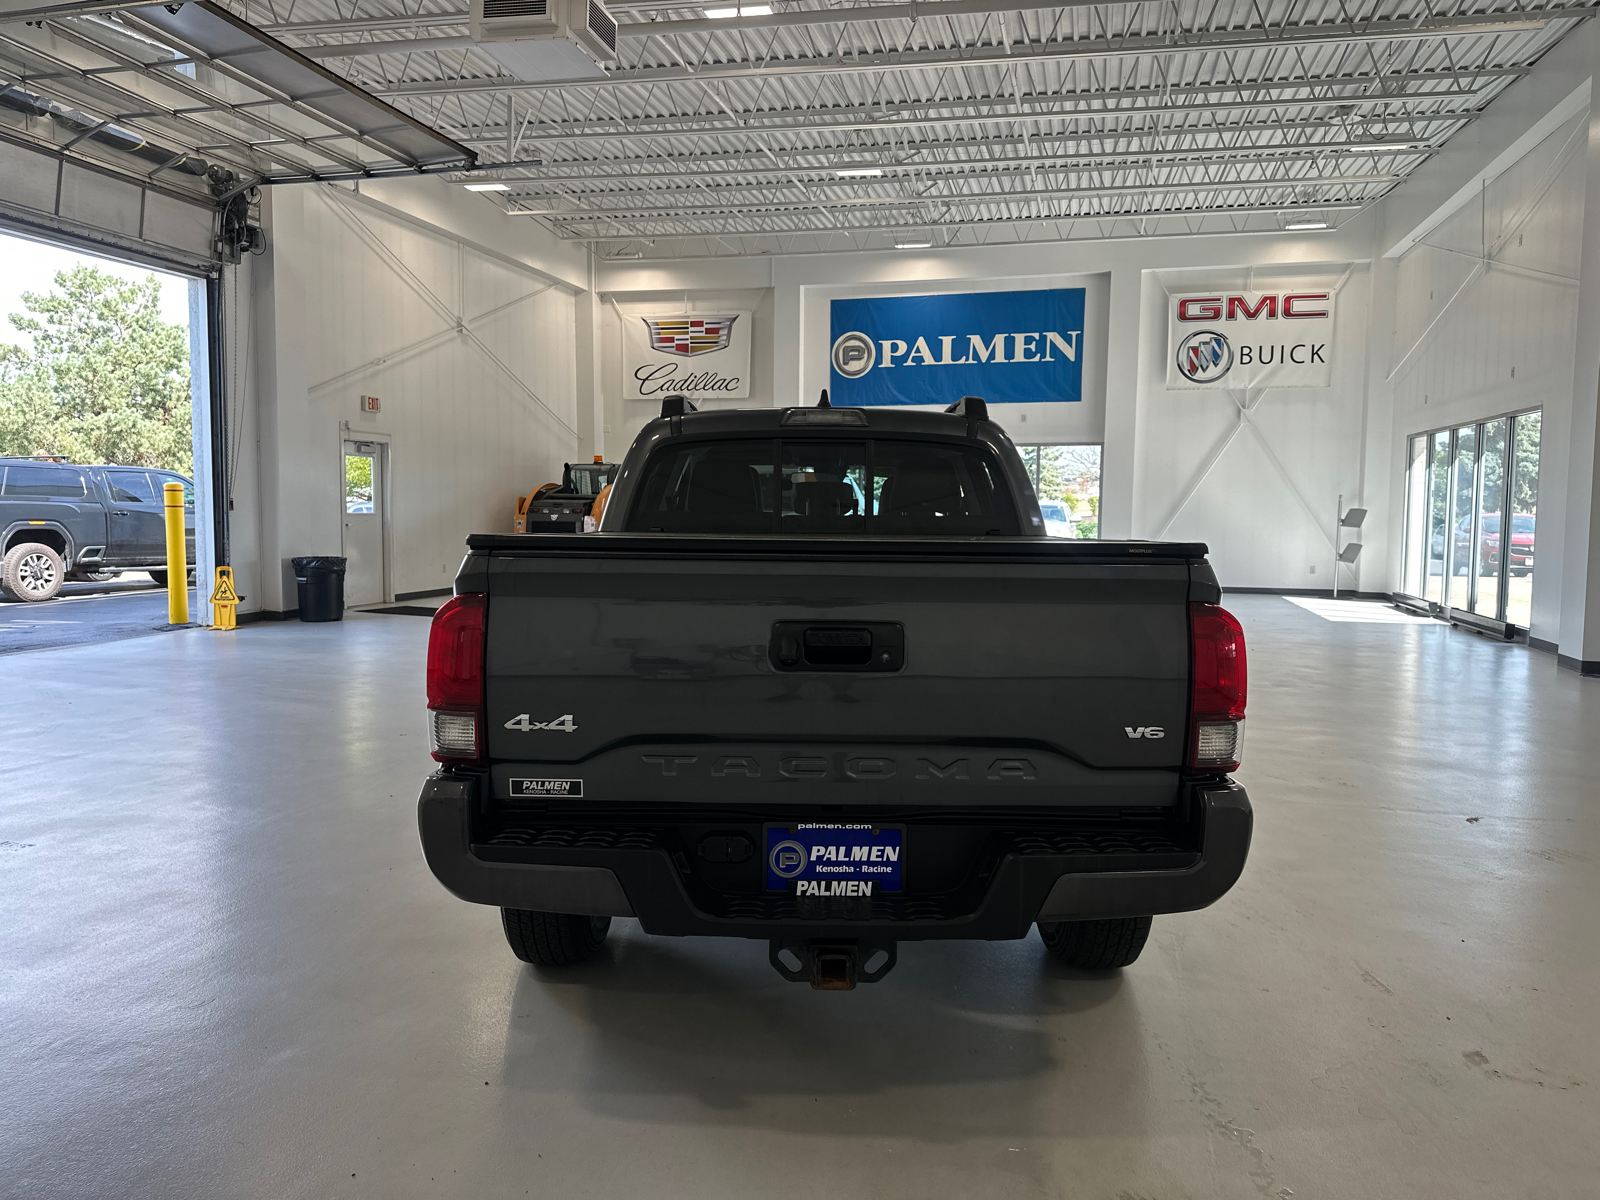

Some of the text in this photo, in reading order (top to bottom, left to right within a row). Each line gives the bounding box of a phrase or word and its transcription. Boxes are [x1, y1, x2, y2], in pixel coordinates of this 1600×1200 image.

[1177, 292, 1330, 322] GMC
[878, 330, 1081, 368] PALMEN
[1240, 344, 1326, 365] BUICK
[634, 362, 740, 396] Cadillac
[368, 397, 379, 411] EXIT
[810, 633, 866, 645] TOYOTA
[504, 713, 579, 733] 4x4
[1124, 726, 1165, 739] V6
[641, 754, 1038, 781] TACOMA
[522, 781, 570, 790] PALMEN
[797, 822, 872, 830] palmen.com
[810, 846, 900, 862] PALMEN
[816, 865, 855, 873] Kenosha
[861, 865, 893, 873] Racine
[796, 880, 873, 897] PALMEN
